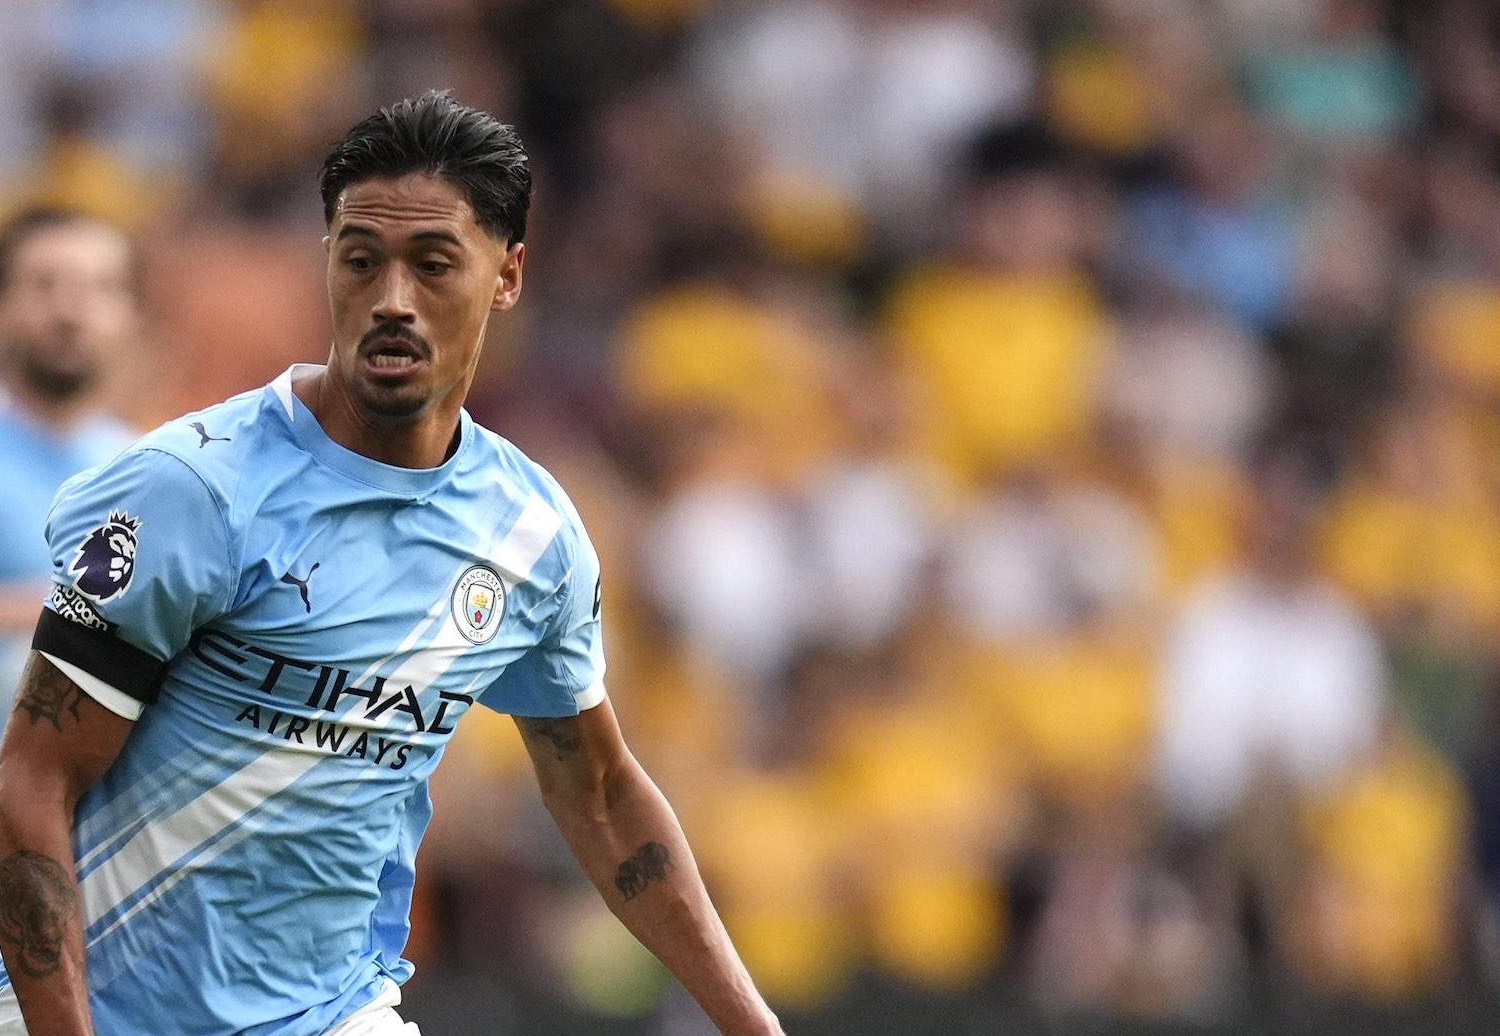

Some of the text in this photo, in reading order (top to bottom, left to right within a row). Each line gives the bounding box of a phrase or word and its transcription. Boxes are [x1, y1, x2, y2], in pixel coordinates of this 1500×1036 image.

[461, 572, 503, 601] MANCHESTER
[71, 594, 108, 632] room
[468, 629, 484, 640] CITY
[190, 627, 475, 735] ETIHAD
[234, 704, 414, 770] AIRWAYS
